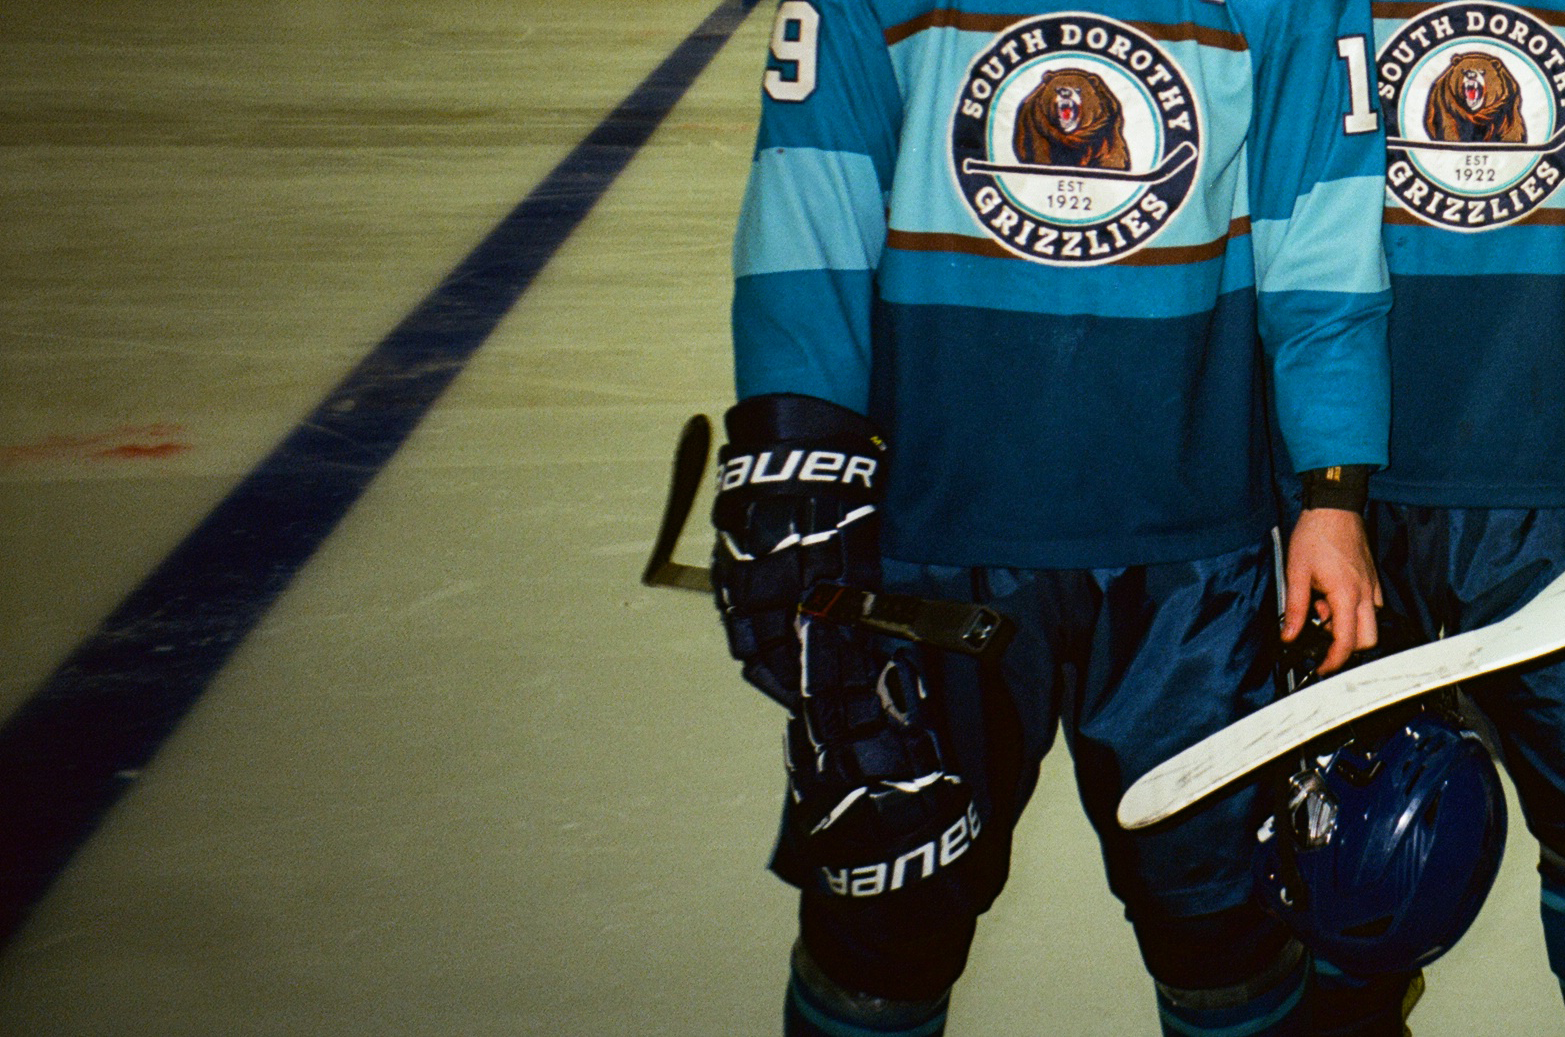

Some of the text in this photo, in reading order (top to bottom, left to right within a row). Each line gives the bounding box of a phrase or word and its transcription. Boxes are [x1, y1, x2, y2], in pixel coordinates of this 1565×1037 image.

[764, 0, 821, 102] 9
[962, 24, 1191, 131] SOUTH DOROTHY
[1378, 15, 1455, 100] SOUTH
[1336, 35, 1379, 135] 1
[1057, 179, 1085, 193] EST
[1387, 160, 1560, 224] GRIZZLIES
[1455, 168, 1496, 182] 1922
[1465, 154, 1489, 166] EST
[974, 185, 1168, 256] GRIZZLIES
[1047, 194, 1092, 211] 1922
[718, 450, 877, 492] AUER
